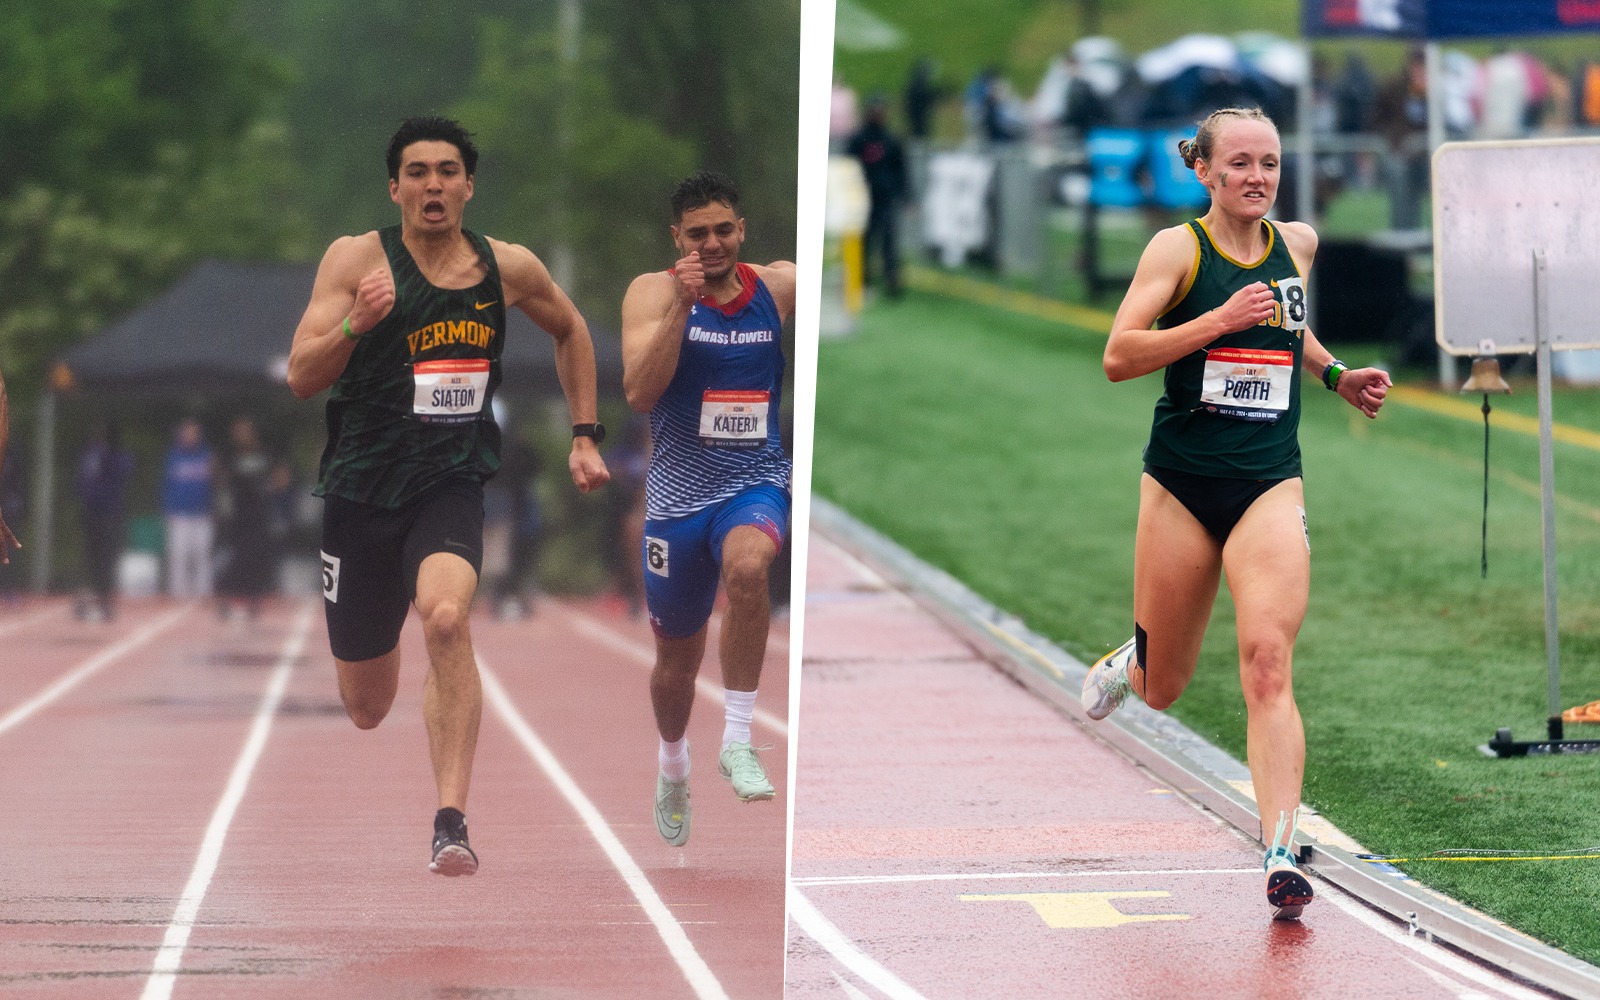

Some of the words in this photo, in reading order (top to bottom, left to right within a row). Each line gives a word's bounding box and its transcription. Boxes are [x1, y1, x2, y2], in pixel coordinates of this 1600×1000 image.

[1286, 286, 1306, 322] 8
[1246, 368, 1257, 376] LILY
[431, 388, 475, 407] SIATON
[1223, 379, 1270, 401] PORTH
[713, 416, 758, 432] KATERJI
[648, 542, 664, 570] 6
[323, 559, 334, 592] 5
